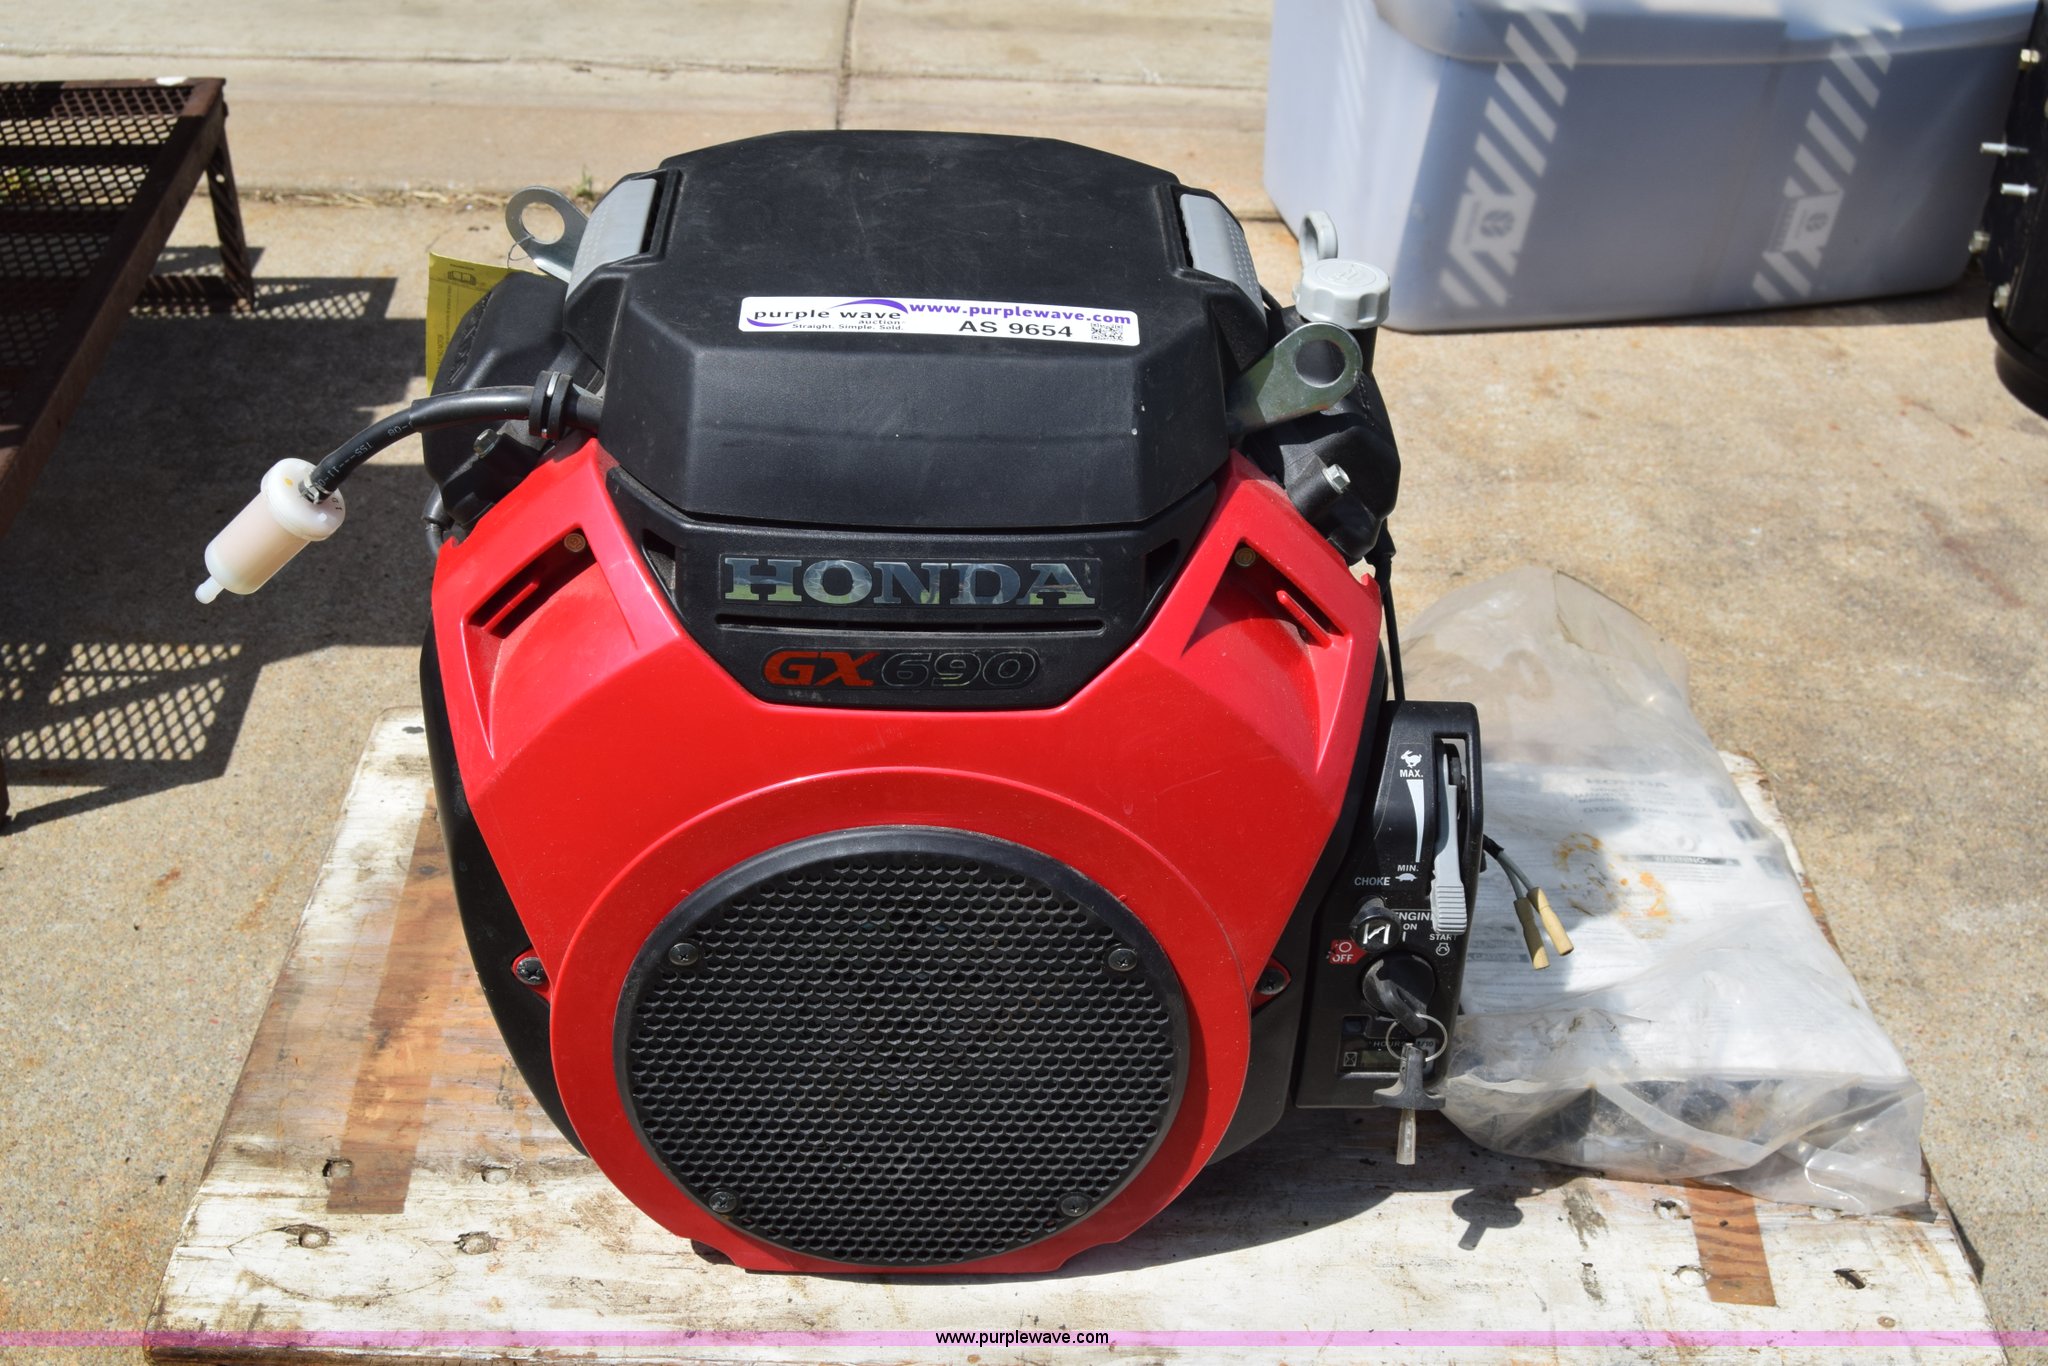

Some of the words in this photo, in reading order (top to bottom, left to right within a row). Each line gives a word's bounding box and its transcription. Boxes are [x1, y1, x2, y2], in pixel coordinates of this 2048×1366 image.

[754, 309, 830, 320] purple
[840, 310, 901, 320] wave
[909, 304, 1131, 325] www.purplewave.com
[792, 322, 834, 330] Straight.
[838, 323, 876, 331] Simple.
[958, 320, 998, 334] AS
[1008, 322, 1073, 338] 9654
[724, 557, 1096, 605] HONDA
[1399, 768, 1424, 778] MAX.
[1397, 864, 1419, 872] MIN.
[1354, 876, 1391, 886] CHOKE
[1396, 911, 1432, 921] NGIN
[1402, 923, 1418, 931] ON
[1332, 954, 1354, 963] OFF
